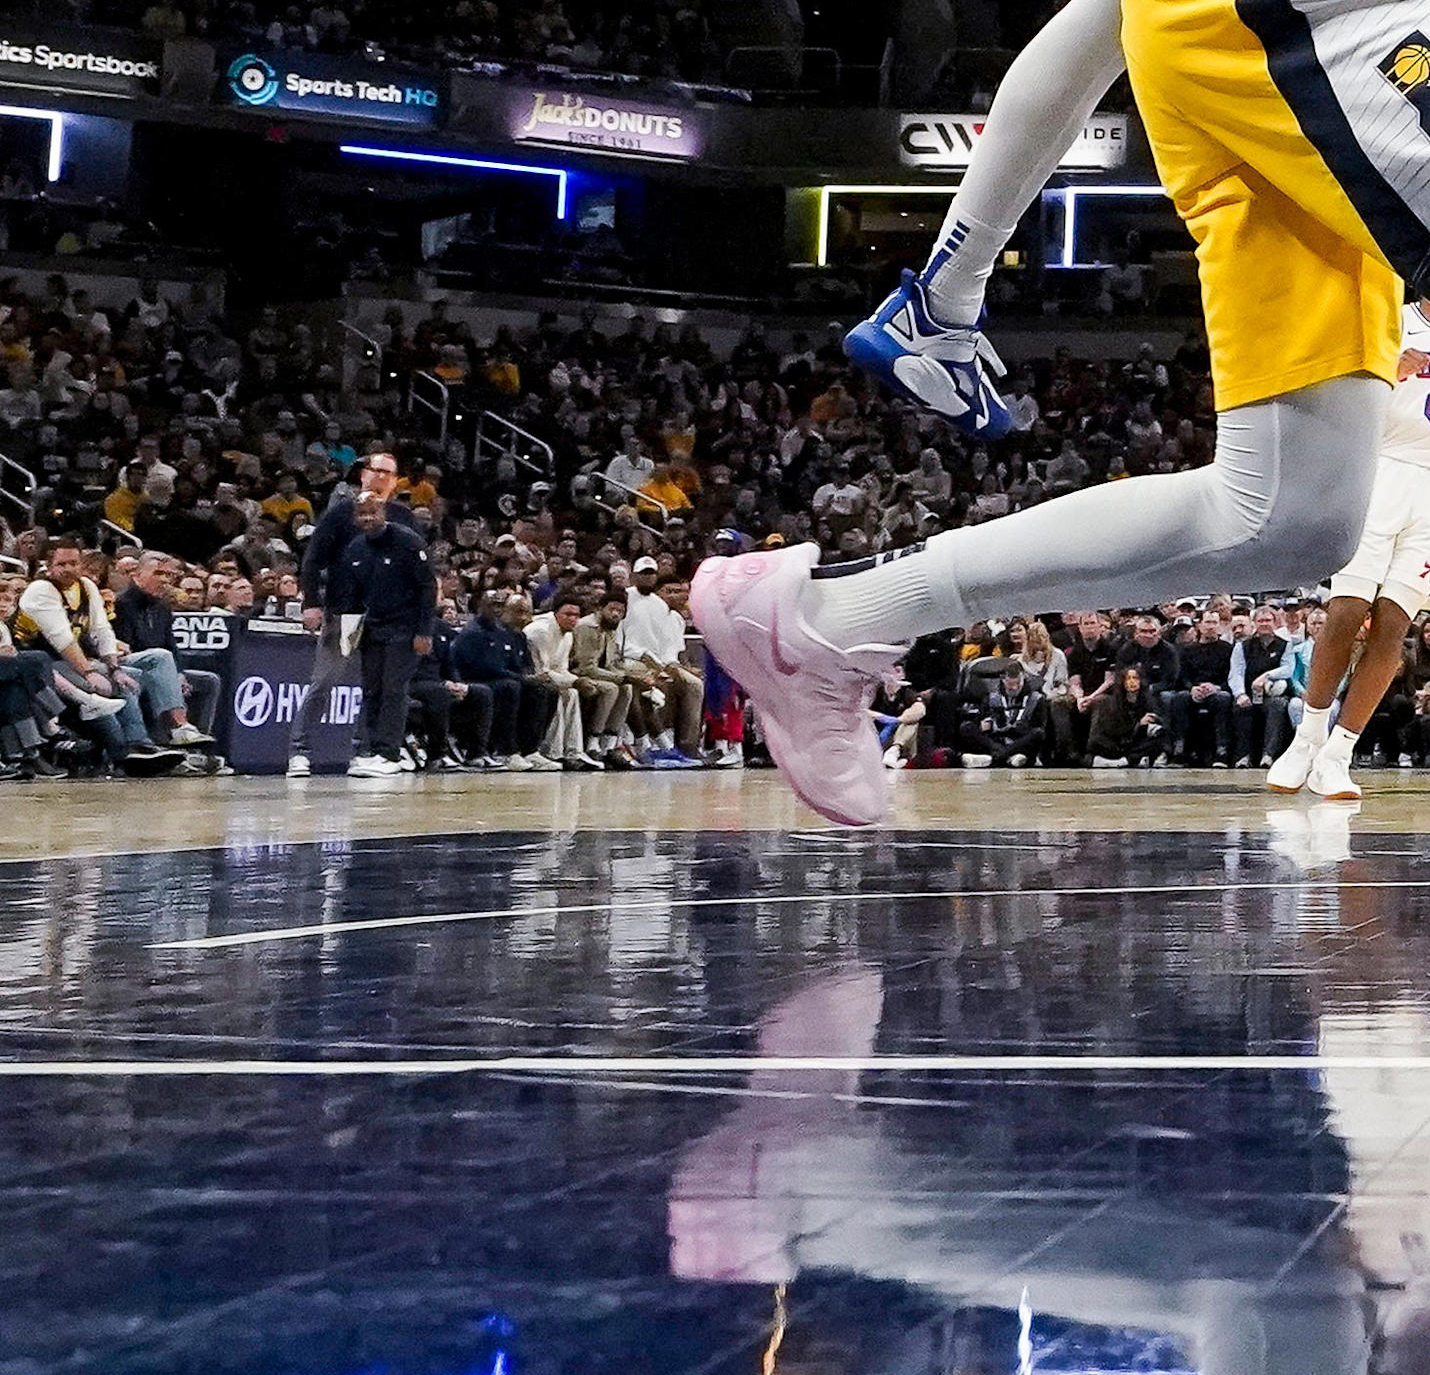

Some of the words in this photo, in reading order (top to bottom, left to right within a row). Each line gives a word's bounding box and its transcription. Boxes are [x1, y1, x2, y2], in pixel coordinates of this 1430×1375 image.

[34, 45, 159, 78] Sportsbook
[285, 73, 354, 97] Sports
[355, 81, 403, 104] Tech
[405, 88, 438, 107] HQ
[584, 107, 683, 139] DONUTS
[1084, 127, 1122, 140] IDE
